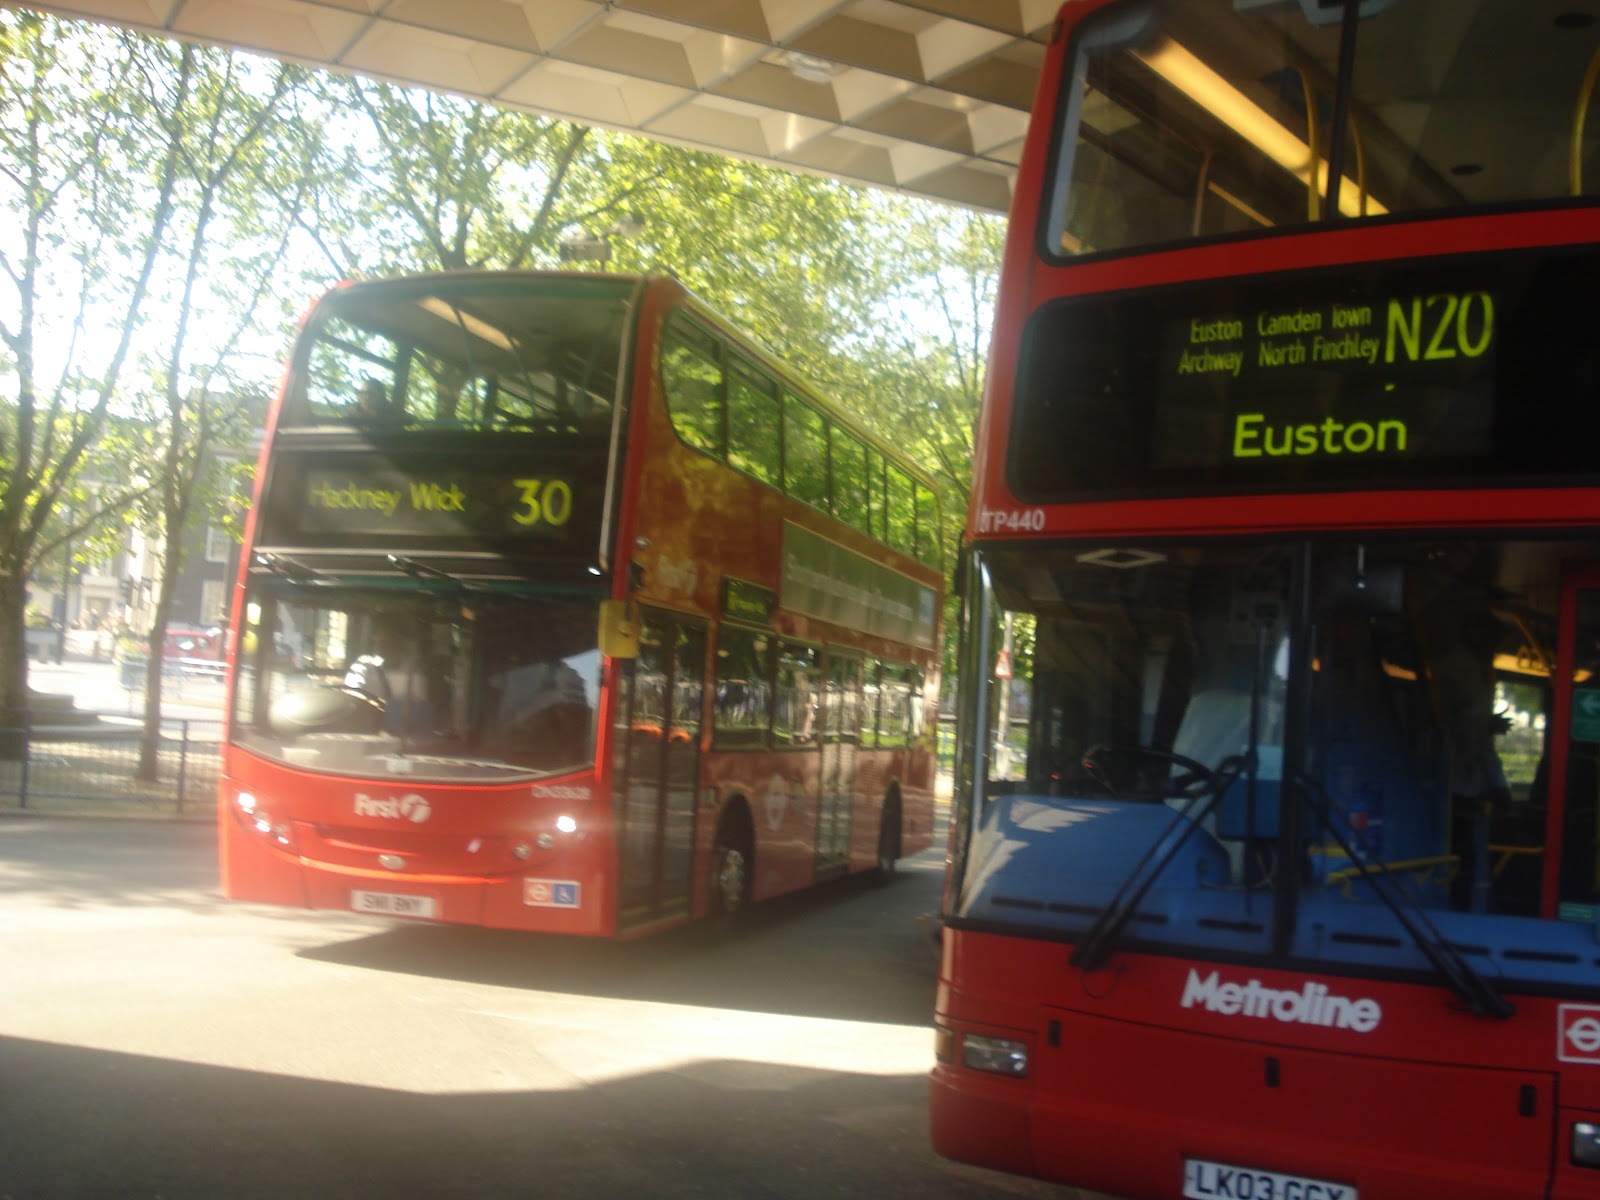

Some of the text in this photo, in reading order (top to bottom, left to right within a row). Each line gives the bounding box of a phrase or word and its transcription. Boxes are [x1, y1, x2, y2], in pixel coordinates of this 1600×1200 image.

[1189, 304, 1372, 344] Euston Camden Town
[1384, 291, 1495, 364] N20
[1177, 332, 1380, 377] Archway North Finchley
[1233, 413, 1408, 458] Euston
[309, 481, 466, 517] Hackney Wick
[511, 478, 573, 527] 30
[353, 792, 400, 820] First
[1180, 967, 1383, 1033] Metroline
[1196, 1164, 1275, 1200] LK03
